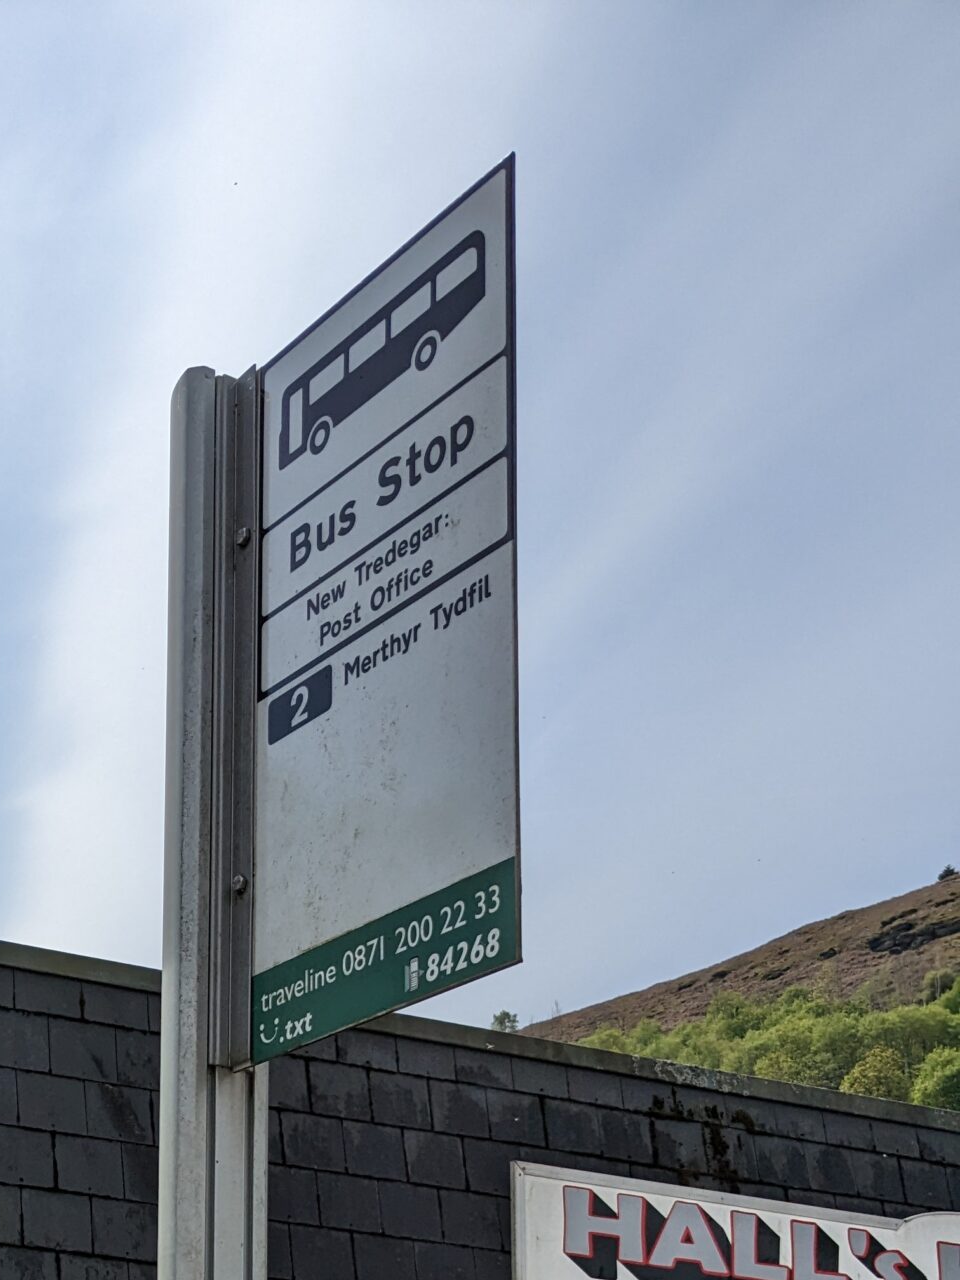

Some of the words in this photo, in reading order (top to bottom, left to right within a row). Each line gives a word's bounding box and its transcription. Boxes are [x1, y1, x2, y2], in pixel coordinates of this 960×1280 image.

[289, 499, 357, 573] Bus
[376, 414, 474, 507] Stop
[306, 577, 347, 621] New
[354, 511, 451, 588] Tredegar:
[319, 606, 362, 647] Post
[369, 556, 435, 613] Office
[290, 685, 311, 728] 2
[343, 624, 422, 687] Merthyr
[430, 573, 492, 632] Tydfil
[261, 964, 337, 1012] traveline
[342, 935, 385, 977] 0871
[394, 915, 433, 955] 200
[440, 900, 467, 935] 22
[474, 884, 500, 919] 33
[425, 927, 500, 983] 84268
